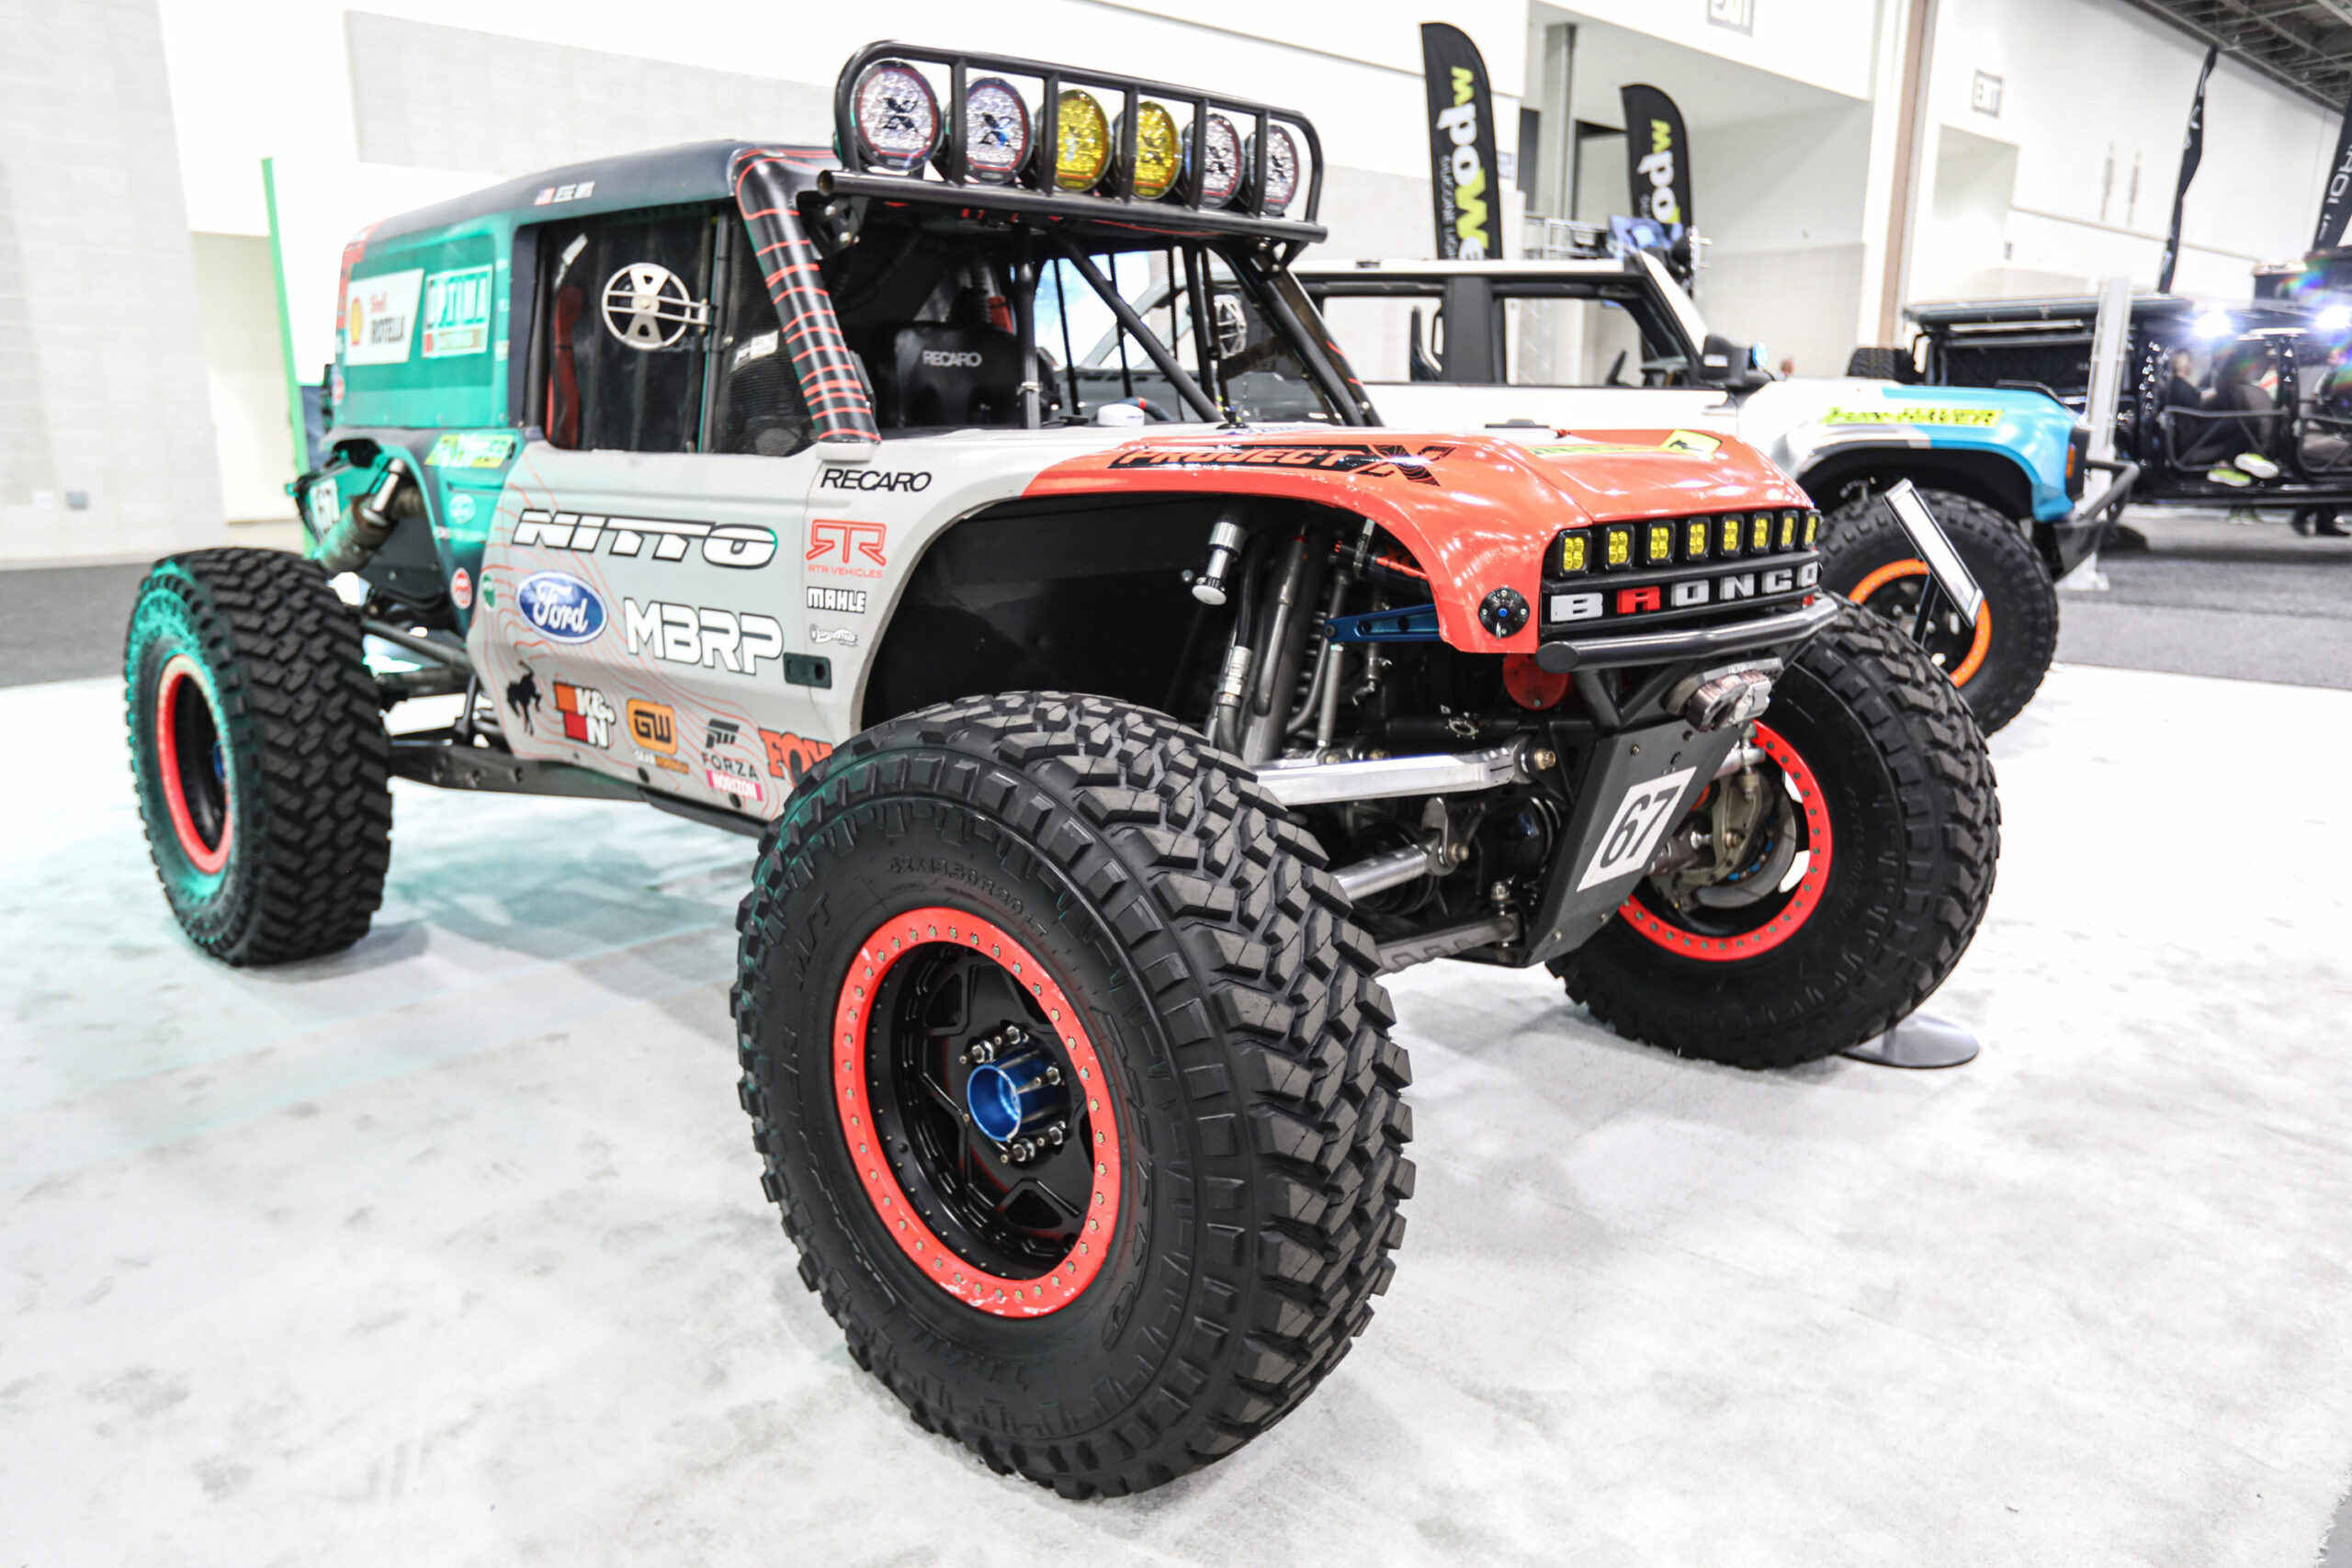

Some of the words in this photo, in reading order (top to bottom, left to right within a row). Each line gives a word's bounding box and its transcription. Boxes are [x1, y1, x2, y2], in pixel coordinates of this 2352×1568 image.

[1637, 118, 1681, 224] mpo
[922, 349, 983, 368] RECARO
[1118, 448, 1368, 467] PROJECT
[820, 468, 933, 492] RECARO
[510, 507, 779, 570] NITTO
[808, 564, 830, 574] RTR
[831, 565, 883, 579] VEHICLES
[807, 586, 866, 615] MAHLE
[1550, 561, 1819, 623] BRONCO
[533, 581, 592, 635] Ford
[623, 597, 785, 677] MBRP
[702, 751, 760, 780] FORZA
[711, 770, 759, 800] HORIZON
[1599, 783, 1681, 869] 67
